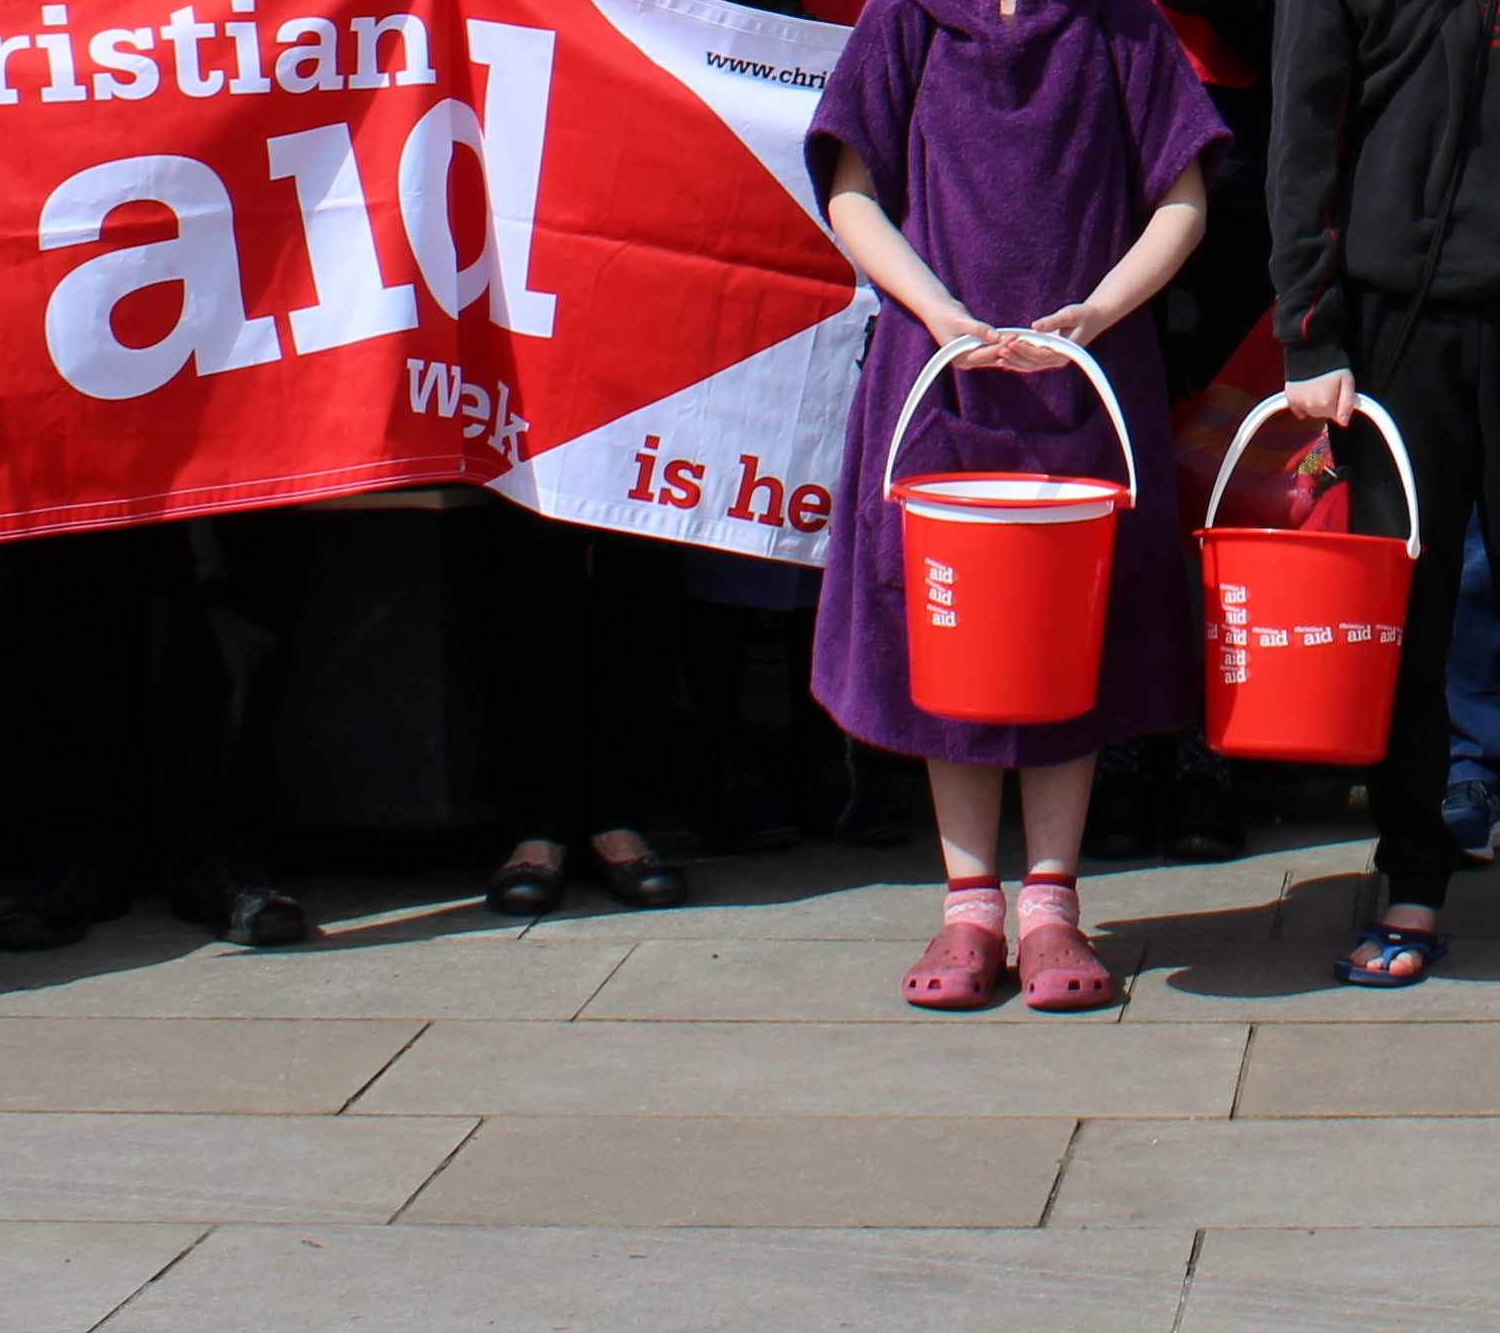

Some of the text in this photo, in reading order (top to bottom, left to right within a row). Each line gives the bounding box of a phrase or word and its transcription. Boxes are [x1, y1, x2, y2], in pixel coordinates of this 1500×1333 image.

[706, 51, 829, 90] www.chri
[38, 18, 558, 401] aid
[406, 357, 531, 463] wek
[627, 434, 833, 537] is he
[930, 566, 954, 585] aid
[929, 588, 953, 606] aid
[1224, 585, 1247, 603] aid
[932, 610, 957, 627] aid
[1225, 607, 1248, 625] aid
[1225, 628, 1248, 646] aid
[1260, 629, 1289, 647] aid
[1303, 626, 1333, 646] aid
[1347, 624, 1372, 643] aid
[1224, 648, 1247, 666] aid
[1224, 666, 1247, 684] aid
